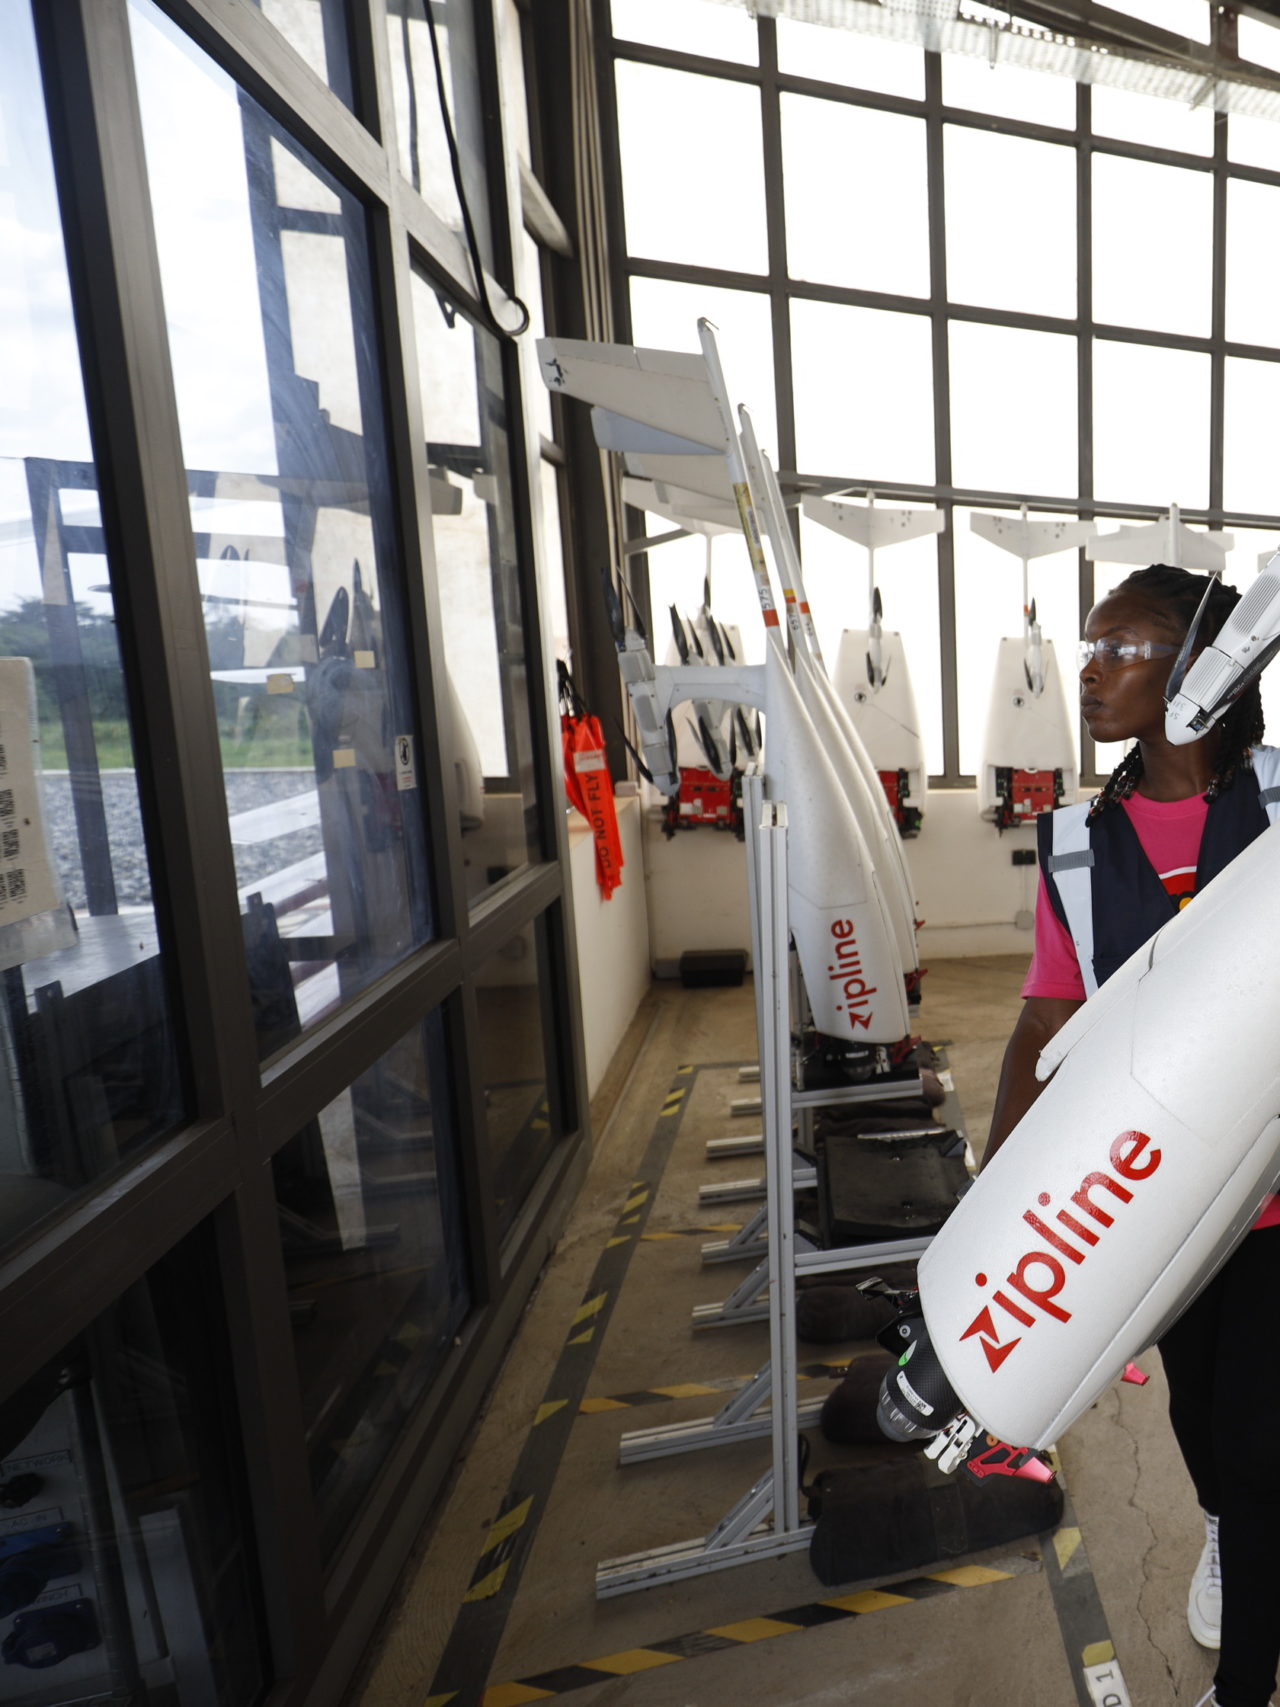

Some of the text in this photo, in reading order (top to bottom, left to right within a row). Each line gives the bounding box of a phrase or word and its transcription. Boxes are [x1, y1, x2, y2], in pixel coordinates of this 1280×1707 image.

[759, 588, 771, 609] 575
[585, 773, 602, 805] FLY
[591, 808, 609, 840] NOT
[827, 919, 877, 1030] zipline
[958, 1130, 1162, 1374] zipline
